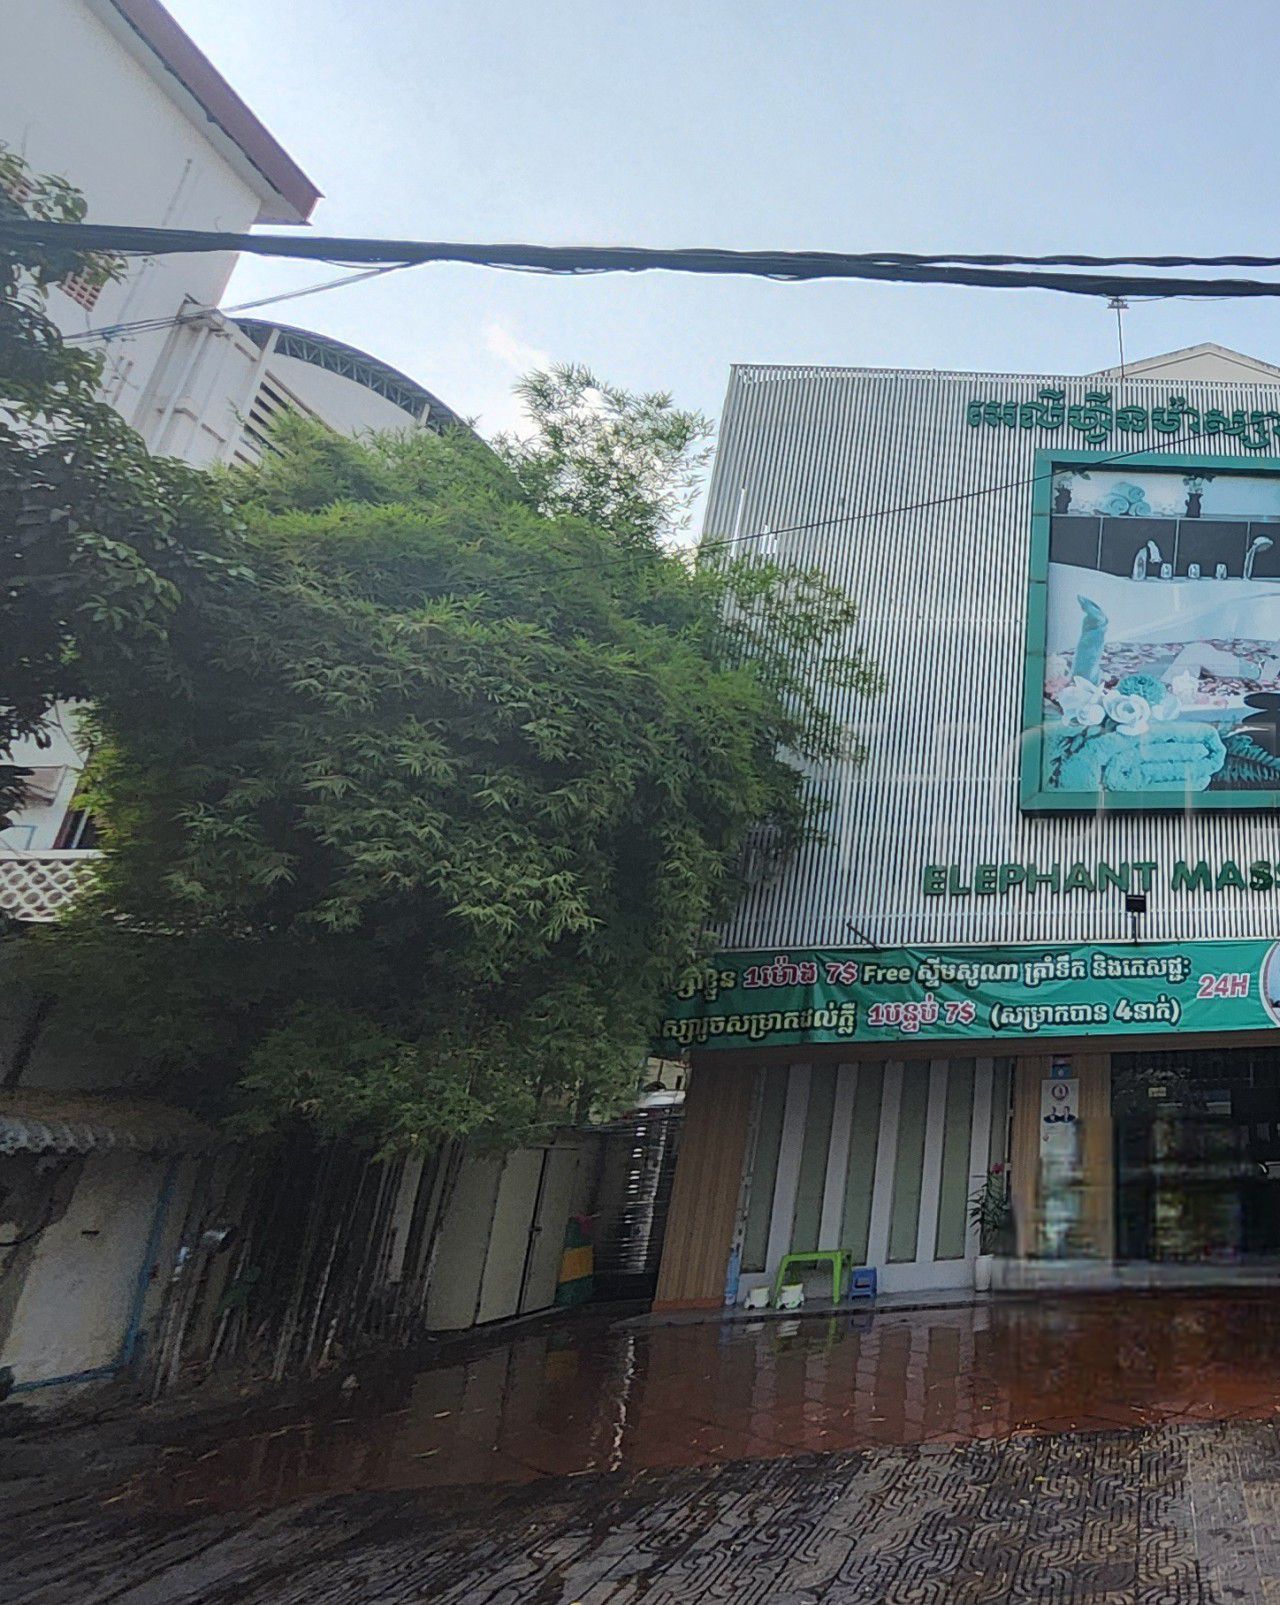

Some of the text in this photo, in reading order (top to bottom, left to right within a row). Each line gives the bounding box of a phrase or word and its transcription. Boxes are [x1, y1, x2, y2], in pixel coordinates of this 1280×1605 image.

[924, 862, 1157, 894] ELEPHANT
[826, 962, 857, 984] 7$
[863, 965, 911, 983] Free
[1197, 974, 1250, 1000] 24H
[945, 1001, 976, 1024] 7$
